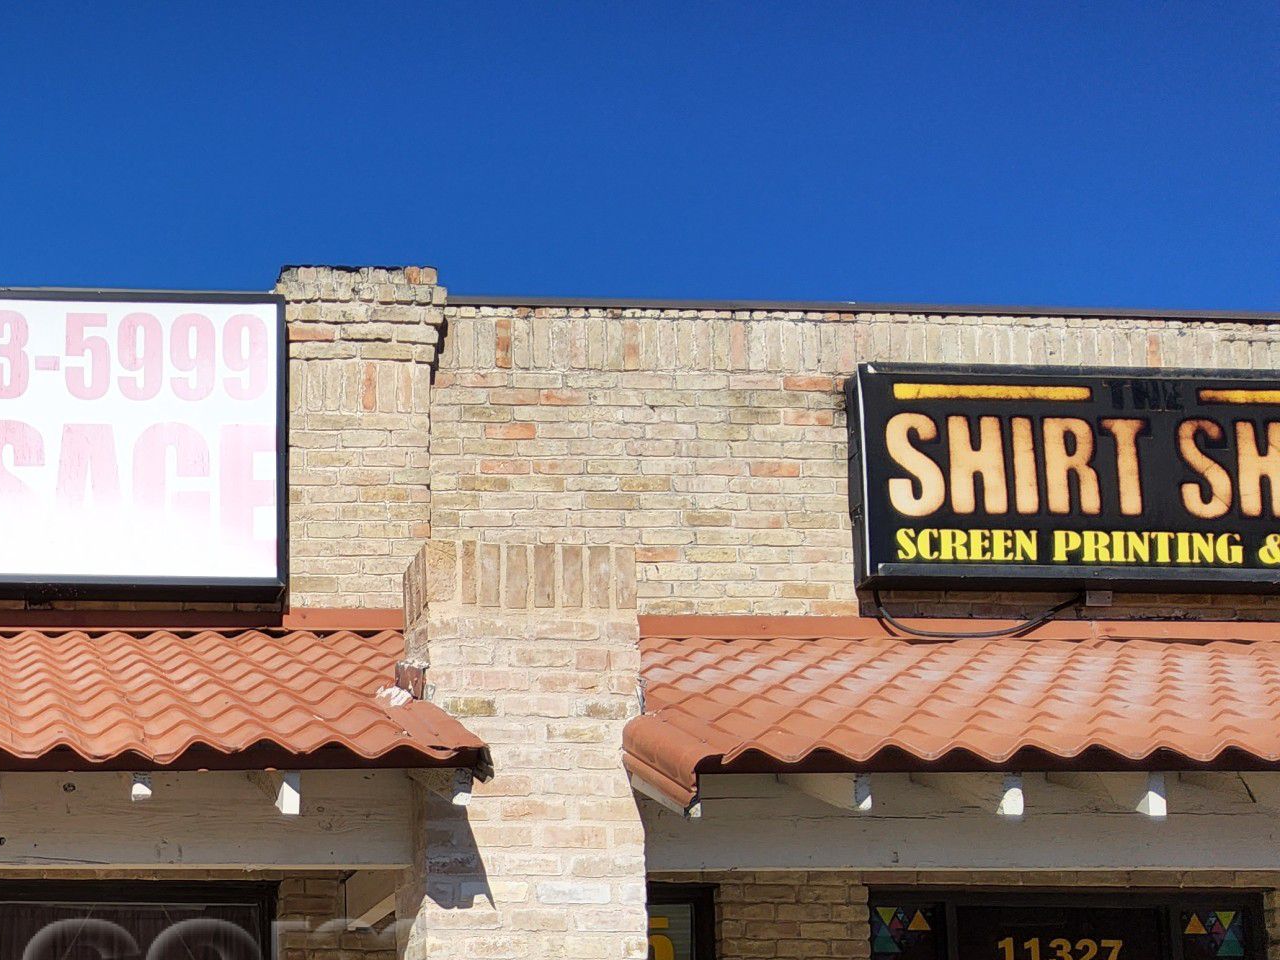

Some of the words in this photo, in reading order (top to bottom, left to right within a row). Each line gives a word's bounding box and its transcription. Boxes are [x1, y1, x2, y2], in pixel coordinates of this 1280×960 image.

[885, 413, 1144, 517] SHIRT
[896, 529, 1038, 562] SCREEN
[1052, 530, 1244, 565] PRINTING
